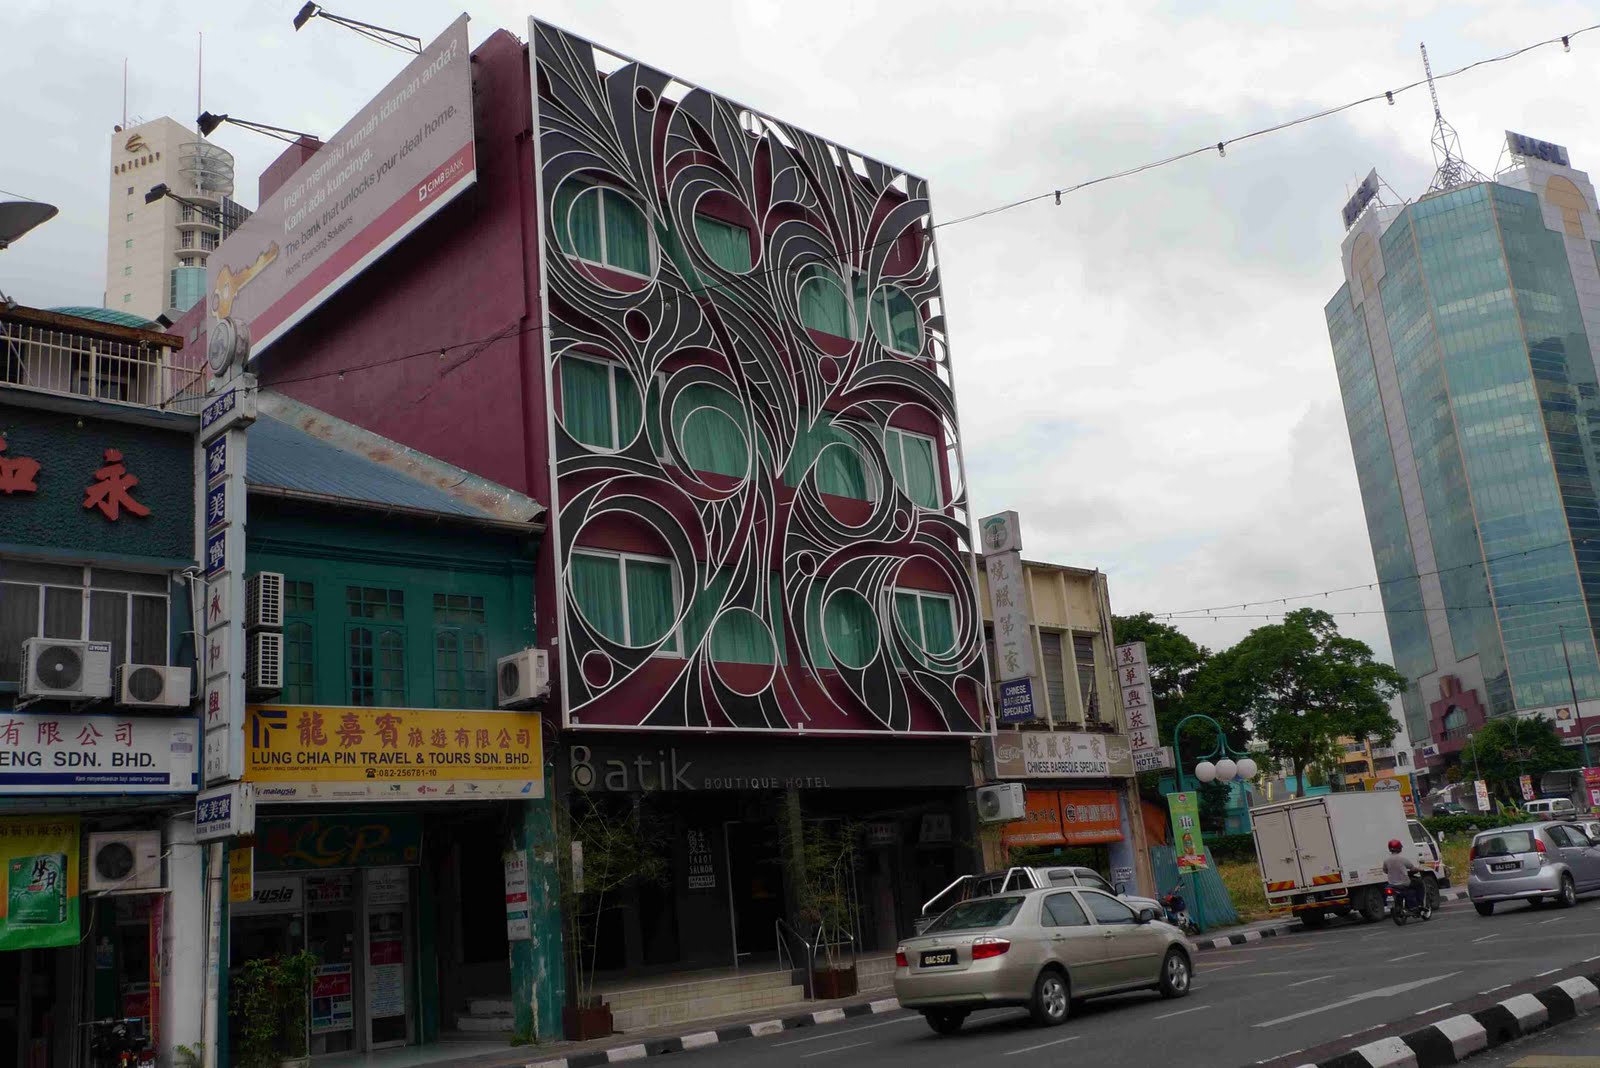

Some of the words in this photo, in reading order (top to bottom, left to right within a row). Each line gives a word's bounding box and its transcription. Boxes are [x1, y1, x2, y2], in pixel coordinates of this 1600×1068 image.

[347, 114, 379, 152] rumah
[380, 78, 420, 123] idaman
[423, 40, 457, 84] anda?
[285, 240, 299, 257] The
[301, 220, 321, 244] bank
[323, 203, 339, 226] that
[341, 176, 375, 210] unlocks
[377, 153, 398, 183] your
[400, 128, 422, 160] ideal
[285, 204, 307, 234] Kami
[1006, 684, 1026, 696] CHINESE
[1004, 704, 1031, 717] SPECIALIST
[0, 719, 133, 747] 有限公司
[0, 751, 42, 767] ENG
[54, 752, 101, 767] SDN.
[112, 752, 156, 768] BHD.
[252, 752, 292, 764] LUNG
[297, 752, 330, 764] CHIA
[334, 752, 356, 764] PIN
[360, 752, 411, 764] TRAVEL
[416, 753, 424, 764] &
[429, 753, 470, 764] TOURS
[474, 753, 502, 764] SDN.
[505, 753, 532, 764] BHD.
[1136, 757, 1162, 767] HOTEL
[570, 745, 697, 793] Batik
[704, 777, 779, 789] BOUTIQUE
[785, 777, 831, 789] HOTEL
[1027, 761, 1050, 773] CHINESE
[1051, 761, 1078, 773] BARBEQUE
[1079, 761, 1106, 773] SPECIALIST
